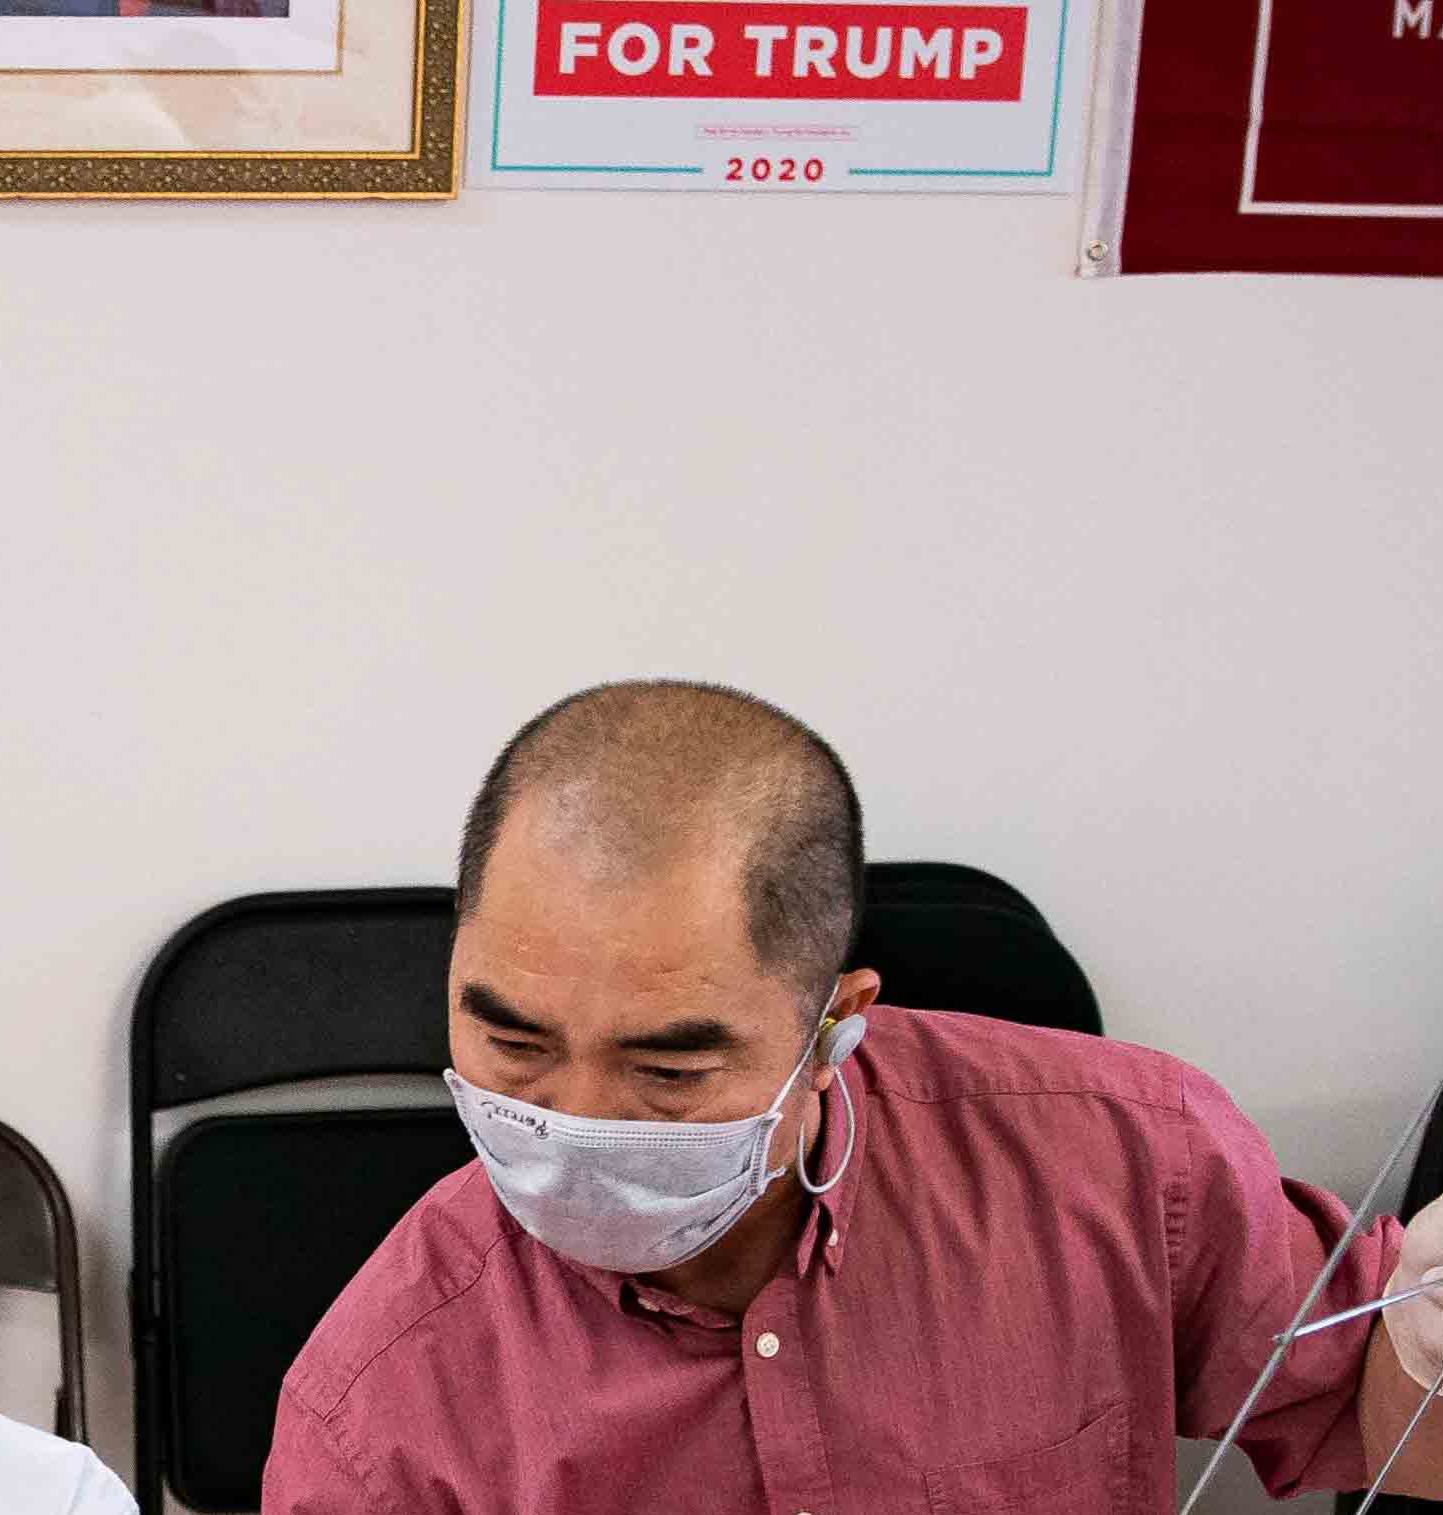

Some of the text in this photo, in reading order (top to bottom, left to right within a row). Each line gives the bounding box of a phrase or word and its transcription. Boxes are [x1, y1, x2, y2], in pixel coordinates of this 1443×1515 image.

[558, 22, 1004, 81] FOR TRUMP
[726, 158, 825, 182] 2020
